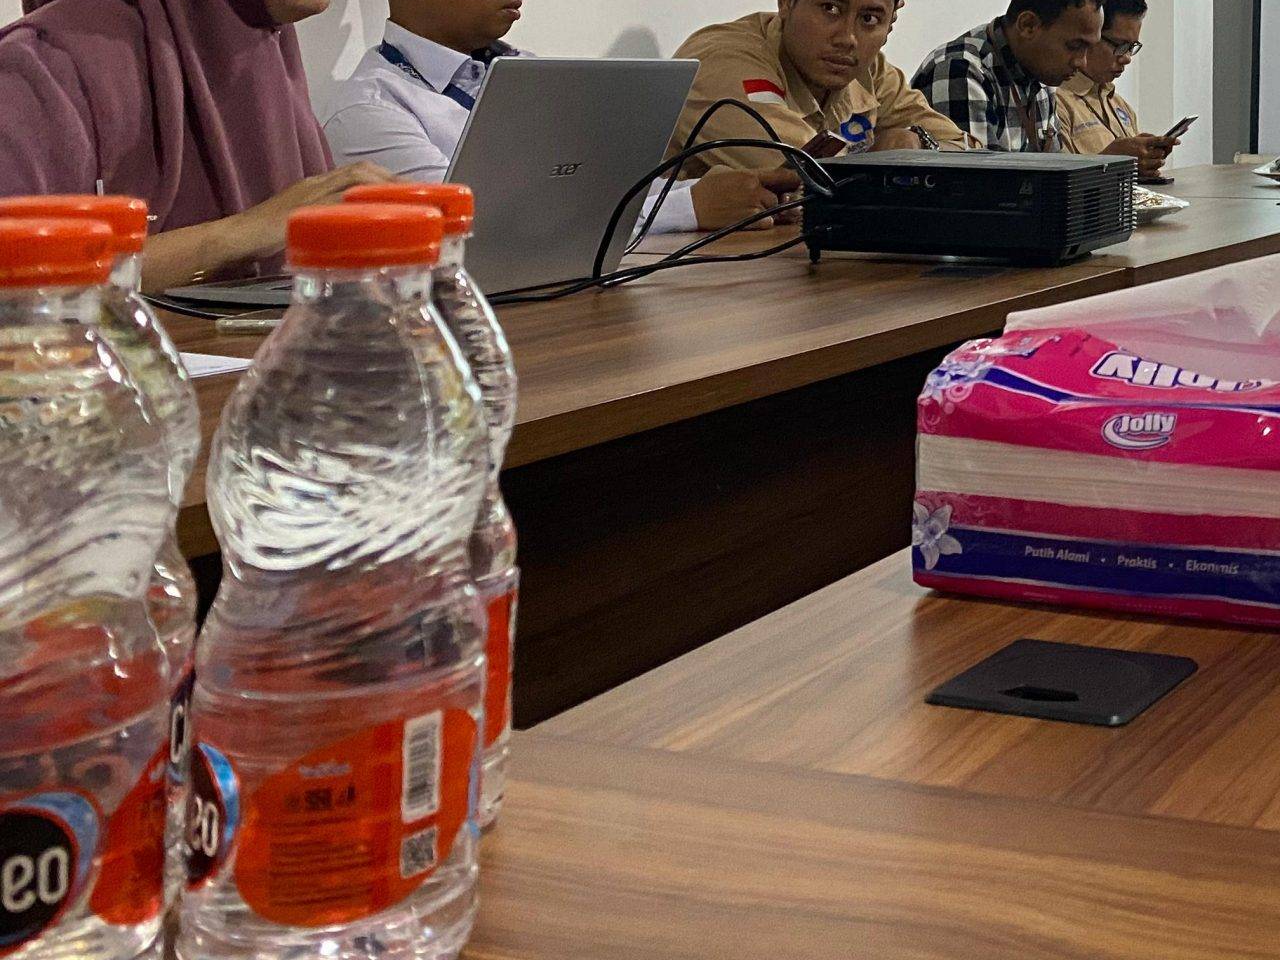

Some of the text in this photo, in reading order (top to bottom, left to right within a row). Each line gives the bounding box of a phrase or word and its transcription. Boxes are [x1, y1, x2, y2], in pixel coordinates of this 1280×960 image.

[549, 160, 583, 178] acer
[1121, 414, 1175, 434] Jolly
[1024, 546, 1055, 560] Putih
[1057, 548, 1090, 564] Alami
[1117, 555, 1157, 570] Praktis
